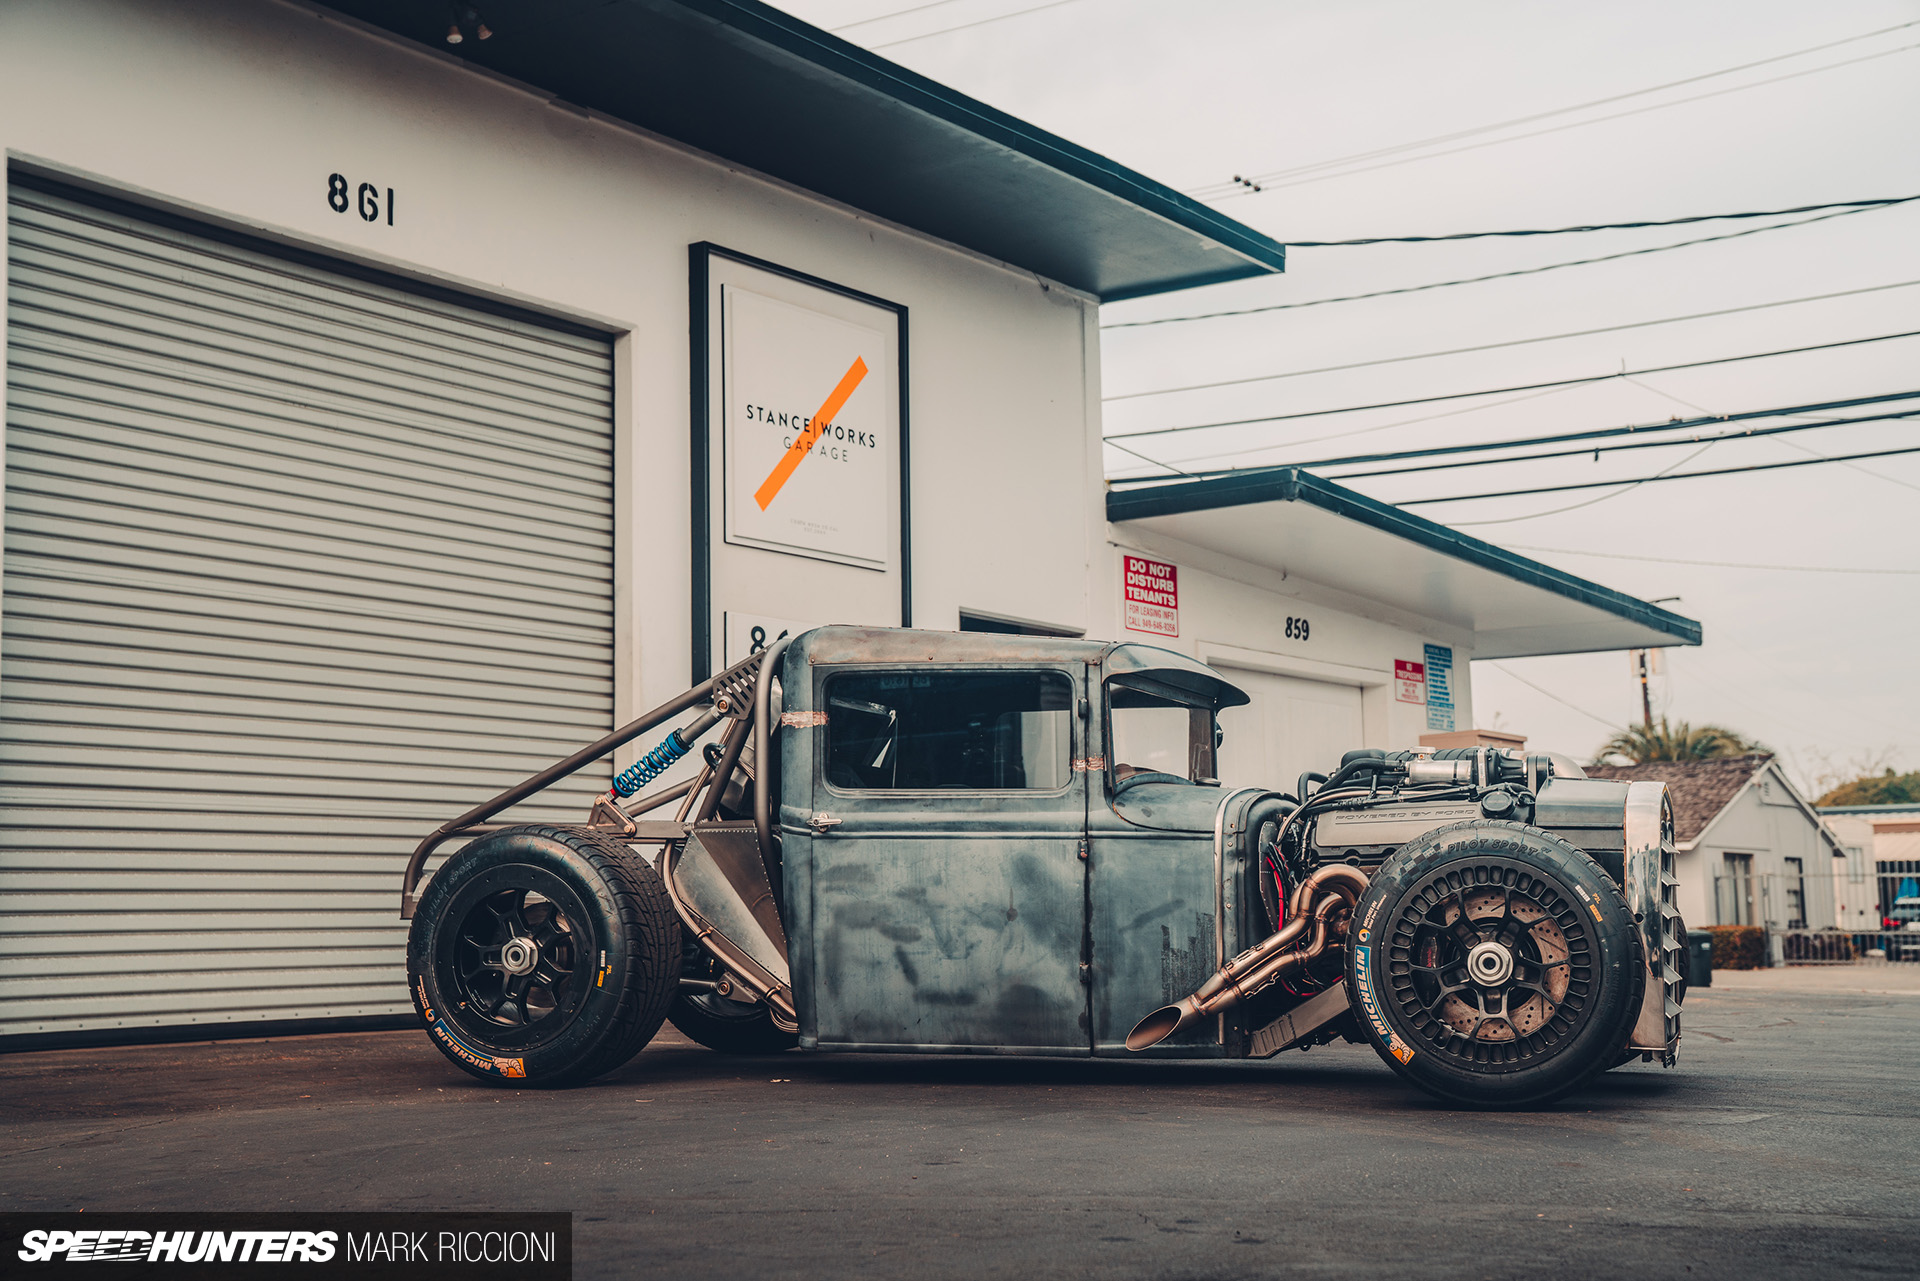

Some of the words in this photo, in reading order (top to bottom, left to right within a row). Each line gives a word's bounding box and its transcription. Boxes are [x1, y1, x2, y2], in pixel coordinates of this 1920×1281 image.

[327, 172, 394, 227] 861
[783, 436, 848, 462] GARAGE
[1129, 559, 1146, 573] DO
[1149, 563, 1171, 578] NOT
[1127, 572, 1174, 592] DISTURB
[1126, 586, 1176, 607] TENANTS
[1128, 616, 1141, 627] CALL
[1129, 604, 1139, 614] FOR
[1140, 606, 1162, 619] LEASING
[1163, 610, 1174, 621] INFO
[1285, 616, 1310, 641] 859
[1335, 812, 1407, 820] POWERED
[1434, 809, 1476, 817] FORD
[1448, 839, 1488, 855] PILOT
[1491, 839, 1539, 858] SPORT
[1356, 949, 1389, 1036] MICHELIN
[433, 1026, 492, 1071] MICHELIN
